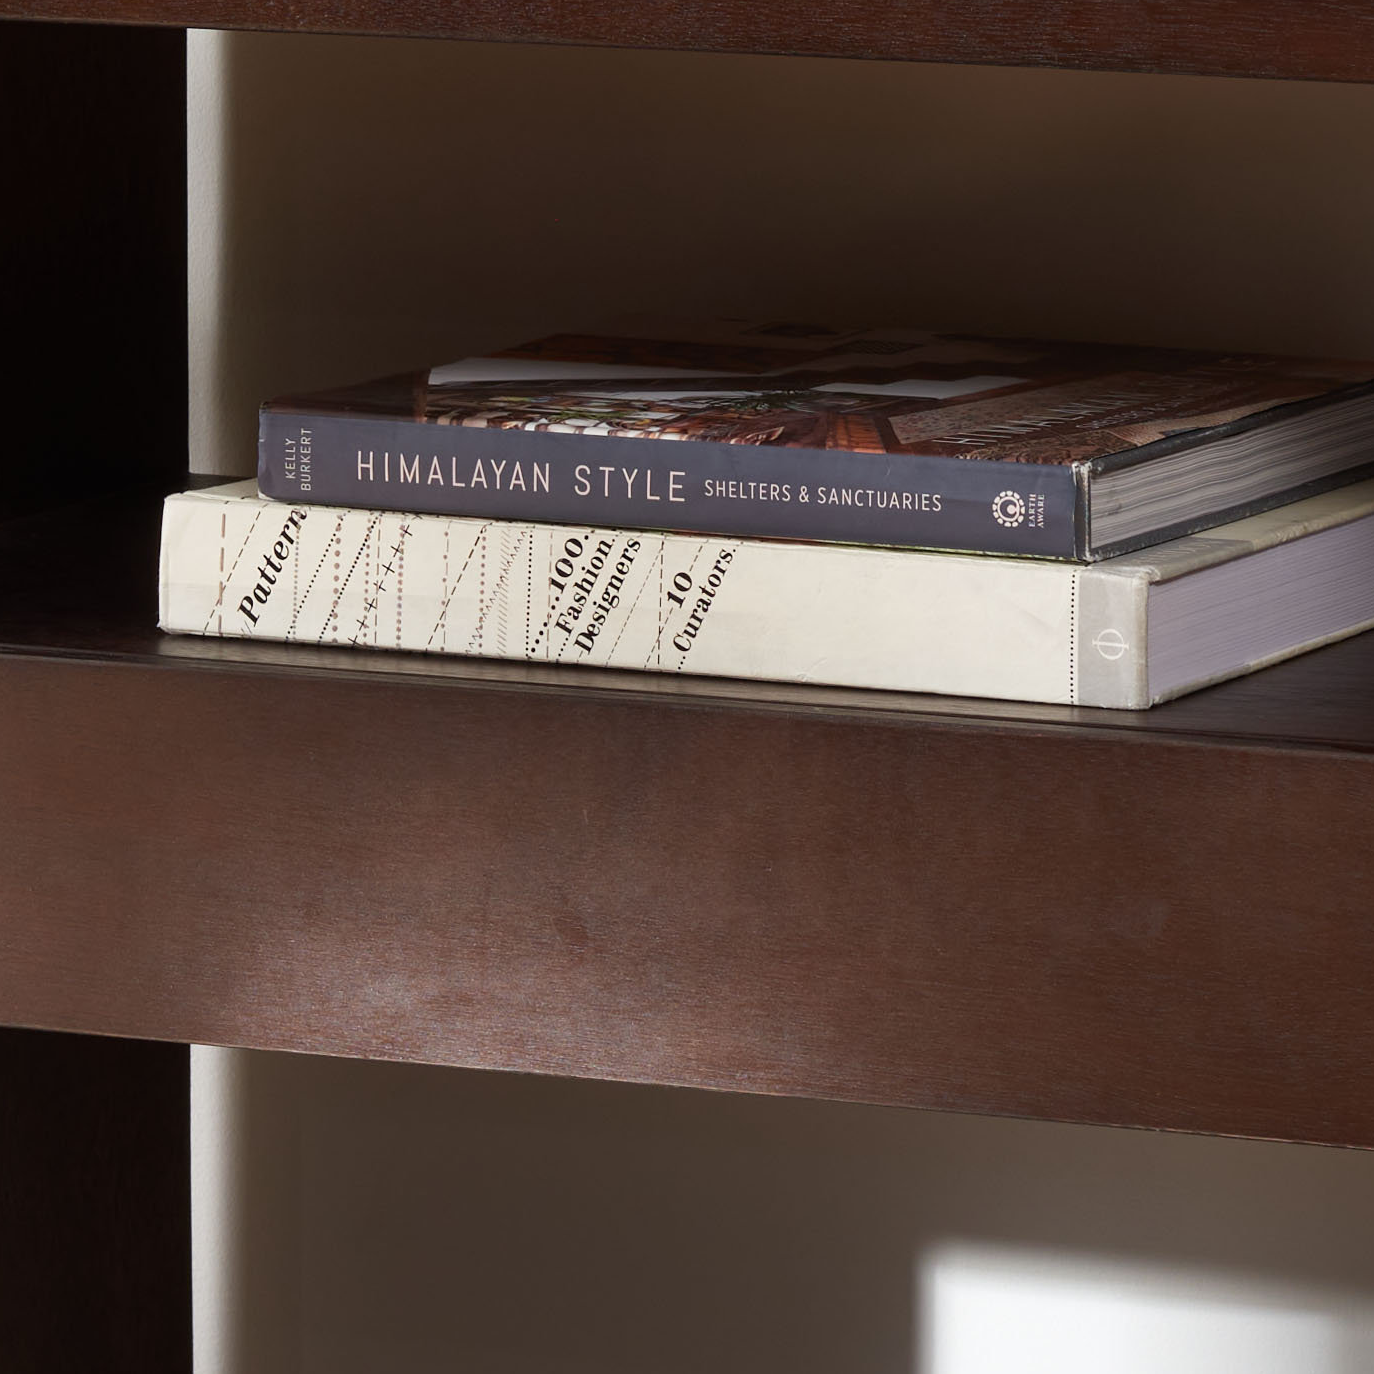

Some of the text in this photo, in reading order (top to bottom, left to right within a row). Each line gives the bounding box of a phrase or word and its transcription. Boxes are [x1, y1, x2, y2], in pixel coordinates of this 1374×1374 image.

[285, 437, 297, 481] KELLY
[300, 427, 313, 492] BURKERT
[357, 450, 943, 513] HIMALAYAN STYLE SHELTERS & SANCTUARIES
[1028, 493, 1037, 528] EARTH
[237, 508, 308, 627] Pattern
[574, 538, 641, 654] Designers
[666, 571, 694, 609] 10
